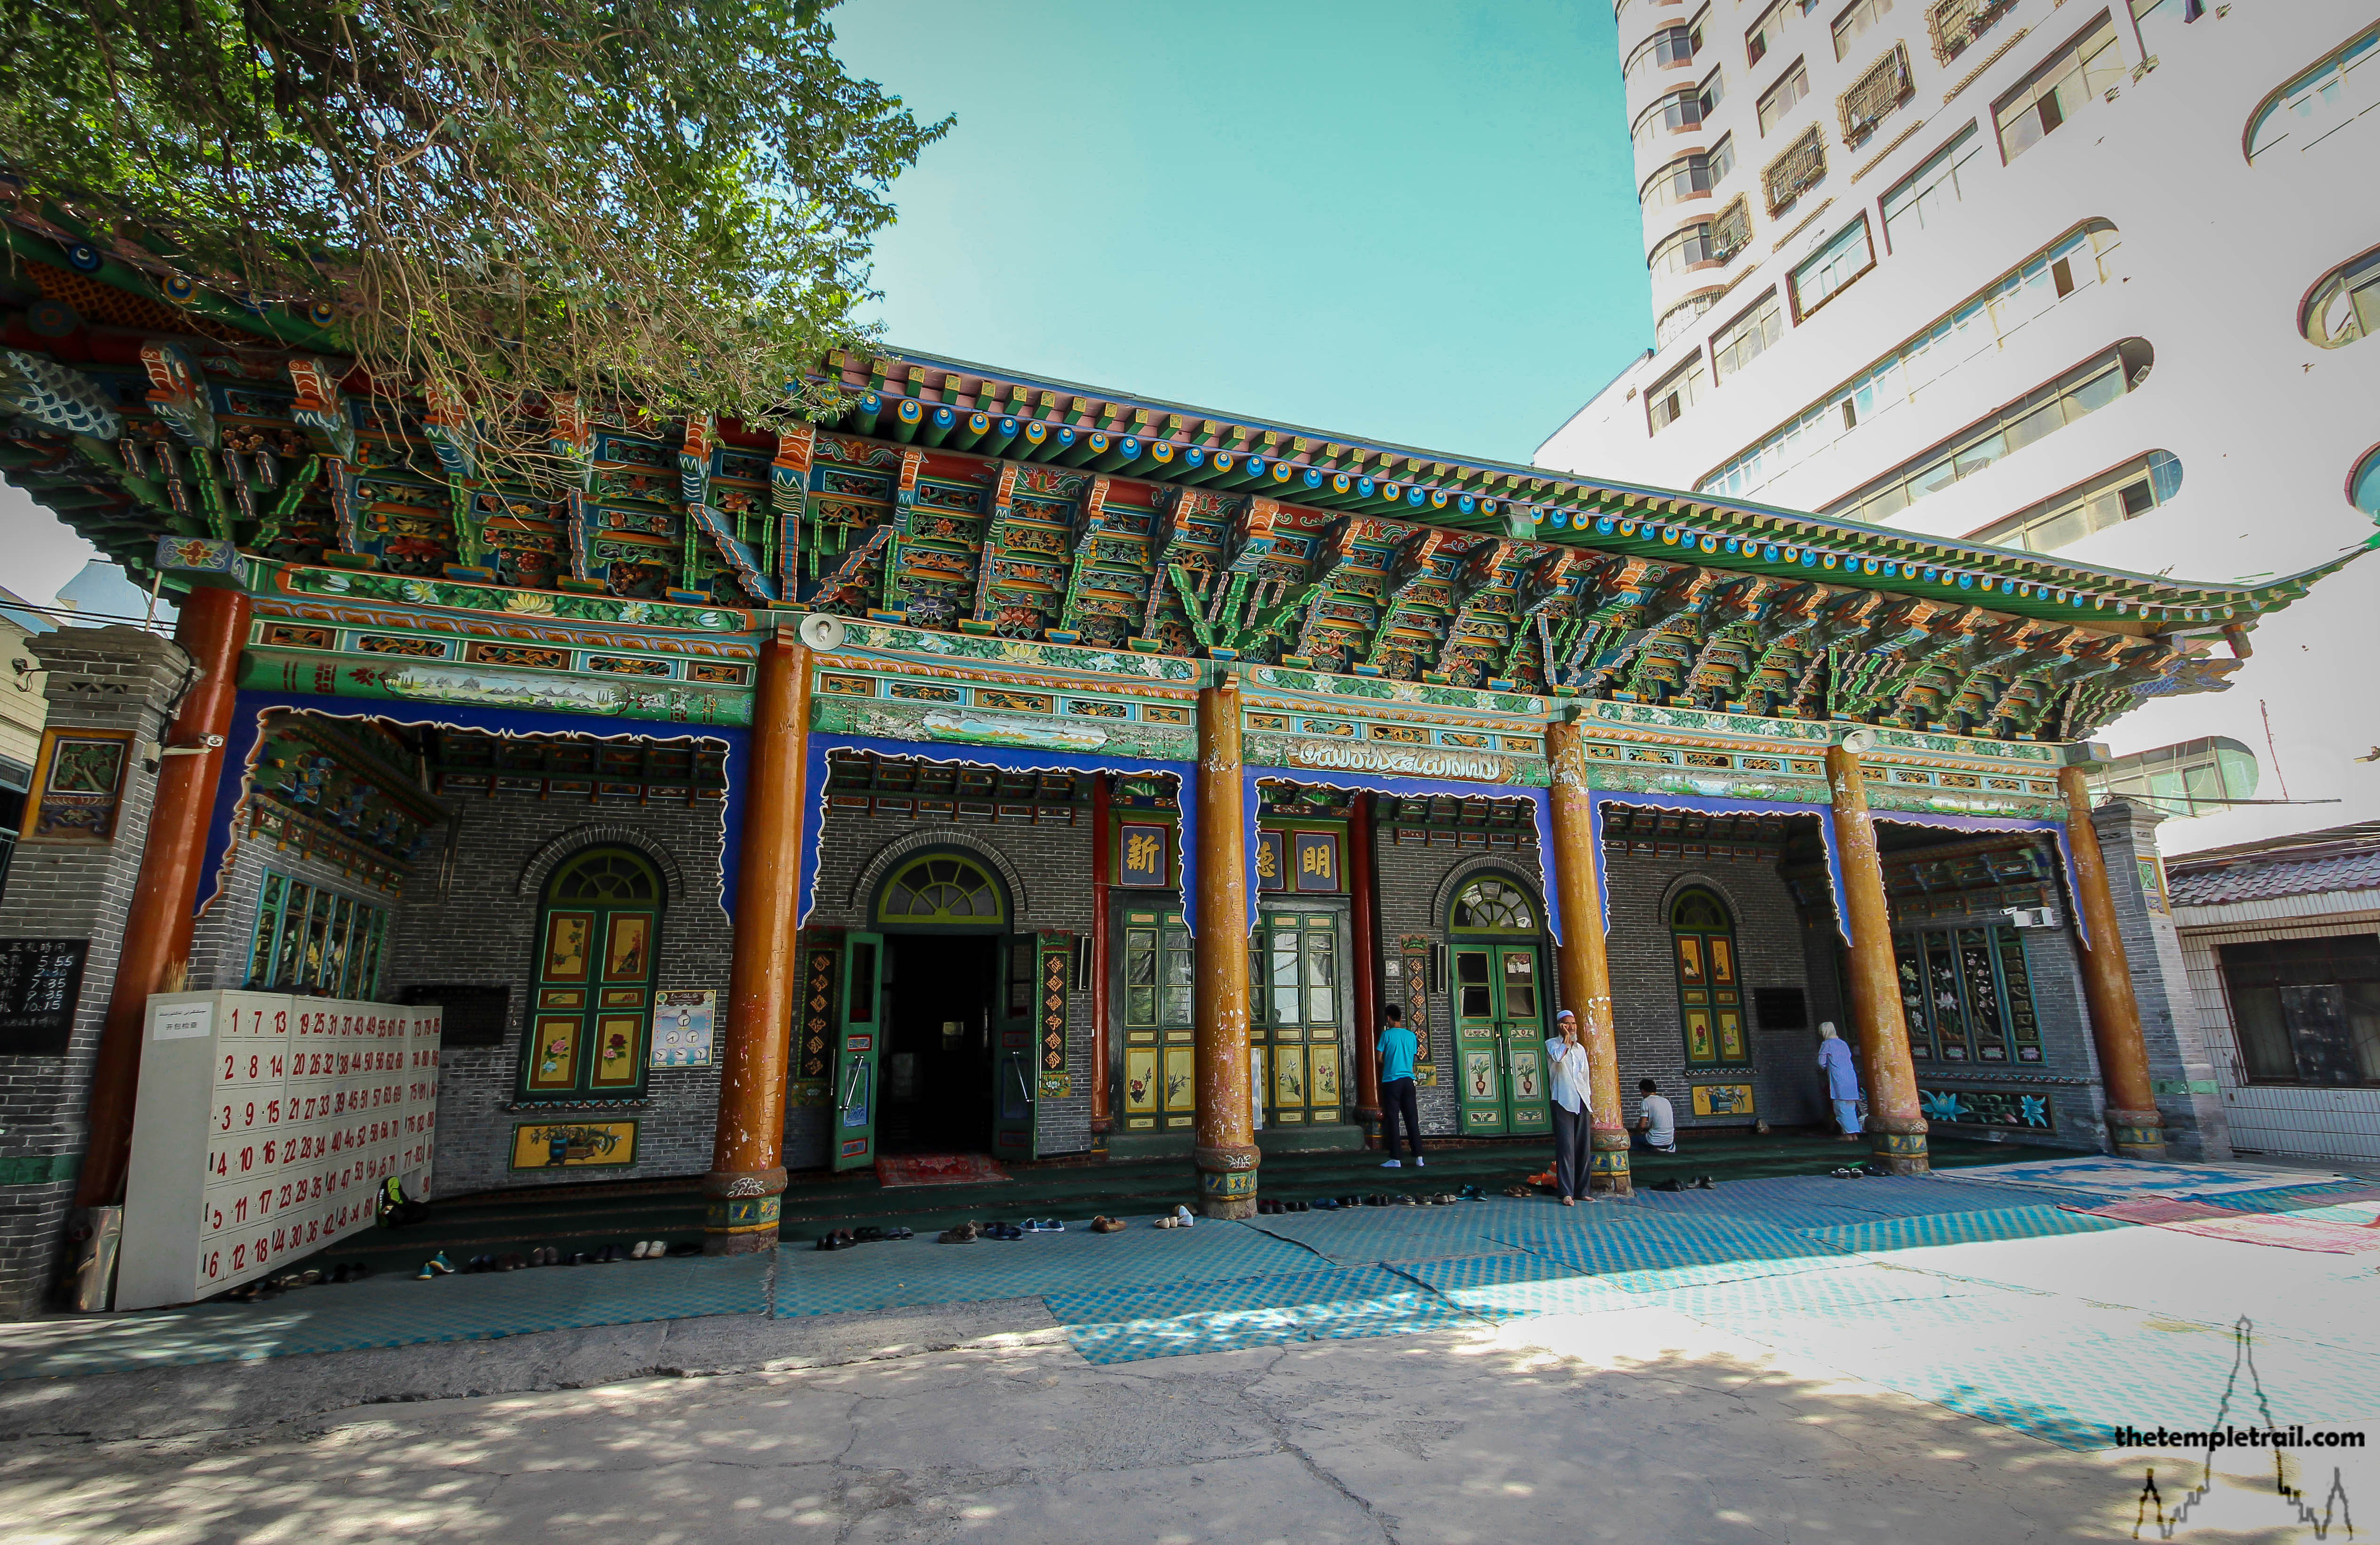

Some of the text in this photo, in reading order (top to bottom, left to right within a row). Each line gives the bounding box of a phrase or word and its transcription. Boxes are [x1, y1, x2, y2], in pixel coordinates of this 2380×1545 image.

[1126, 833, 1160, 874] 新
[1303, 845, 1330, 878] 明
[31, 978, 65, 988] 7:35
[34, 967, 67, 977] 2:30
[23, 1001, 60, 1011] 10:15
[27, 990, 63, 1001] 9:35
[232, 1009, 238, 1032] 1
[254, 1011, 262, 1033] 7
[274, 1011, 286, 1033] 13
[300, 1013, 309, 1034] 19
[314, 1013, 324, 1033] 25
[328, 1014, 337, 1035] 31
[342, 1016, 351, 1036] 37
[354, 1017, 363, 1035] 43
[366, 1017, 376, 1034] 49
[378, 1020, 386, 1037] 55
[388, 1019, 395, 1037] 61
[398, 1019, 406, 1036] 67
[414, 1020, 421, 1037] 73
[424, 1019, 431, 1035] 79
[225, 1055, 233, 1080] 2
[249, 1055, 257, 1078] 8
[270, 1054, 282, 1077] 14
[293, 1053, 305, 1075] 20
[309, 1053, 321, 1075] 26
[323, 1053, 333, 1074] 32
[339, 1055, 348, 1075] 38
[352, 1052, 361, 1071] 44
[364, 1052, 372, 1072] 50
[221, 1105, 231, 1130] 3
[245, 1102, 254, 1126] 9
[267, 1100, 279, 1123] 15
[288, 1097, 300, 1120] 21
[304, 1098, 316, 1120] 27
[319, 1095, 329, 1116] 33
[334, 1092, 345, 1113] 39
[348, 1091, 358, 1110] 45
[360, 1089, 368, 1109] 51
[373, 1088, 381, 1107] 57
[410, 1083, 417, 1102] 75
[217, 1152, 227, 1176] 4
[240, 1146, 253, 1172] 10
[263, 1140, 276, 1164] 16
[283, 1138, 296, 1164] 22
[300, 1136, 312, 1159] 28
[314, 1135, 325, 1159] 34
[331, 1131, 342, 1152] 40
[357, 1126, 365, 1148] 52
[391, 1120, 399, 1138] 70
[408, 1115, 415, 1134] 76
[417, 1115, 424, 1133] 82
[213, 1210, 222, 1229] 5
[235, 1197, 247, 1222] 11
[260, 1190, 272, 1214] 17
[279, 1184, 292, 1209] 23
[295, 1179, 307, 1203] 29
[311, 1176, 322, 1198] 35
[327, 1172, 336, 1194] 41
[341, 1169, 351, 1190] 47
[355, 1160, 364, 1181] 53
[389, 1155, 395, 1173] 71
[404, 1149, 412, 1168] 77
[209, 1251, 219, 1278] 6
[233, 1244, 245, 1270] 12
[254, 1238, 267, 1262] 18
[273, 1229, 285, 1252] 24
[290, 1224, 301, 1249] 30
[307, 1220, 317, 1243] 36
[323, 1214, 335, 1236] 42
